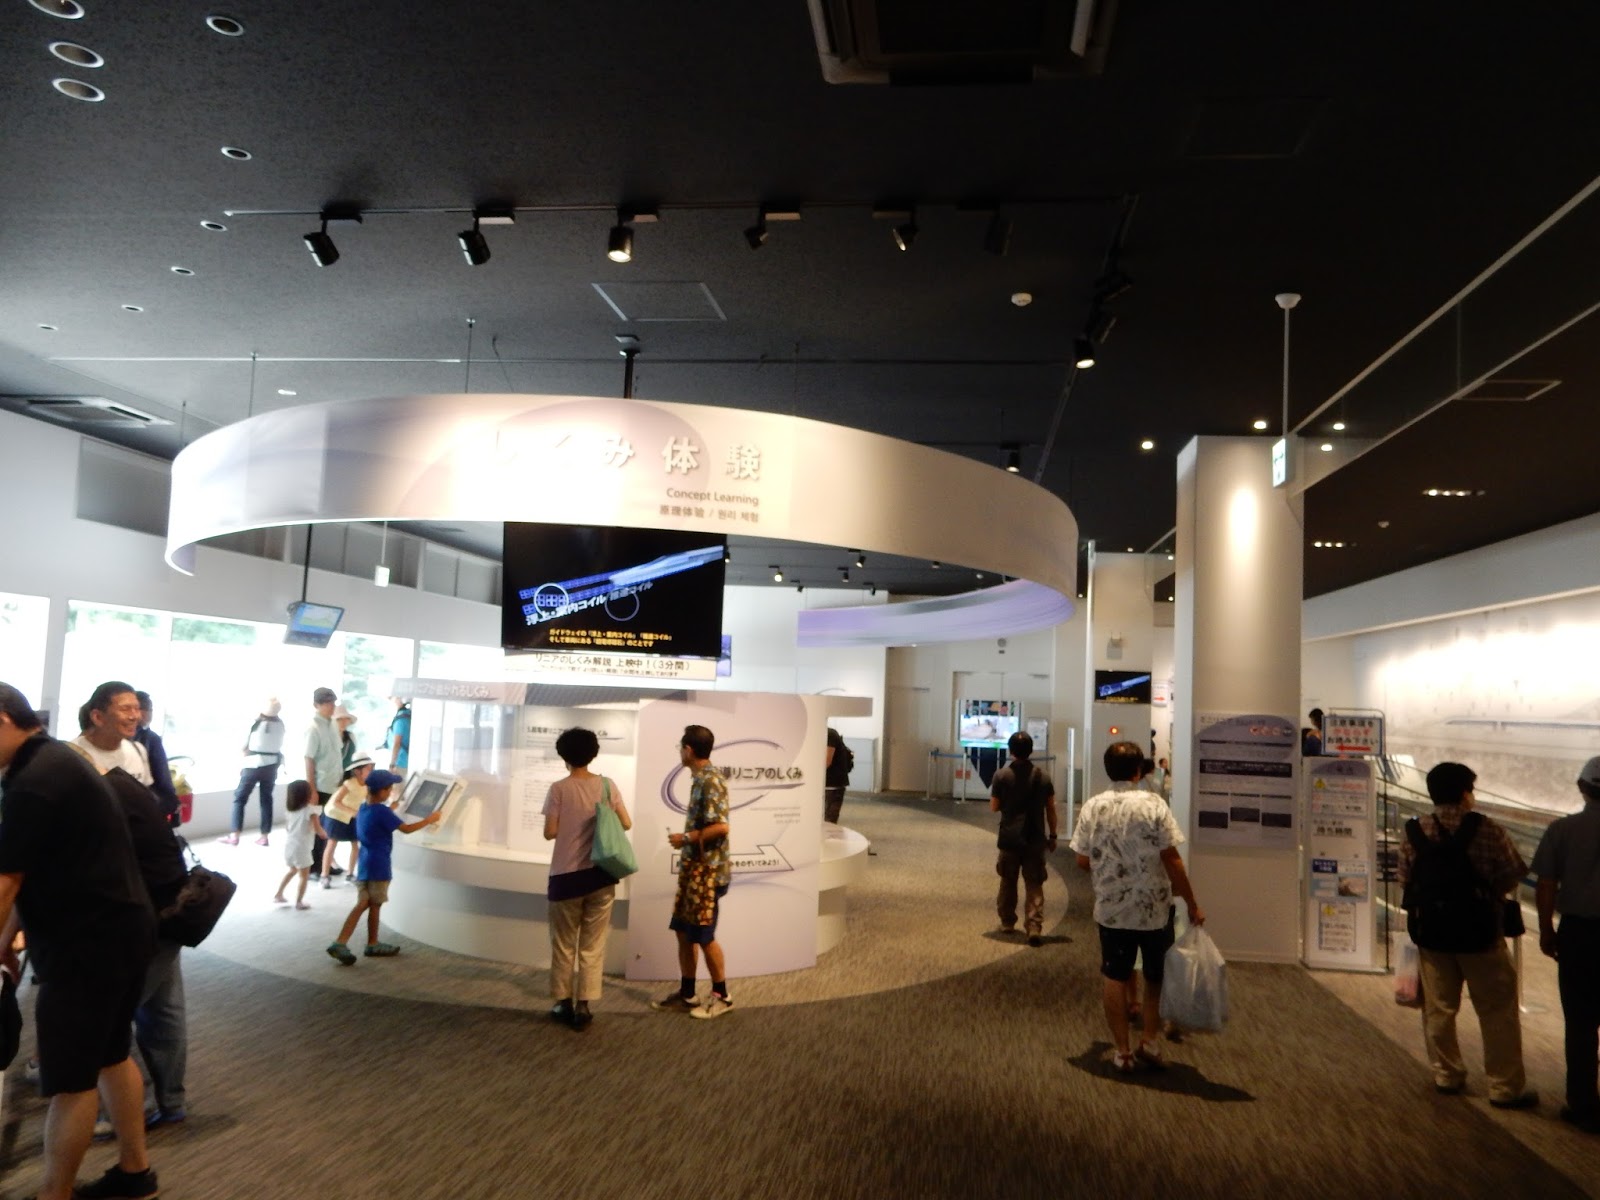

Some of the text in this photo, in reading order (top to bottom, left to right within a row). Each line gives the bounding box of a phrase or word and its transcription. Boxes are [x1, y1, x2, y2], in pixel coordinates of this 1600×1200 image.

[666, 487, 760, 508] Concept Learning
[718, 766, 803, 781] 導リニアのしくみ
